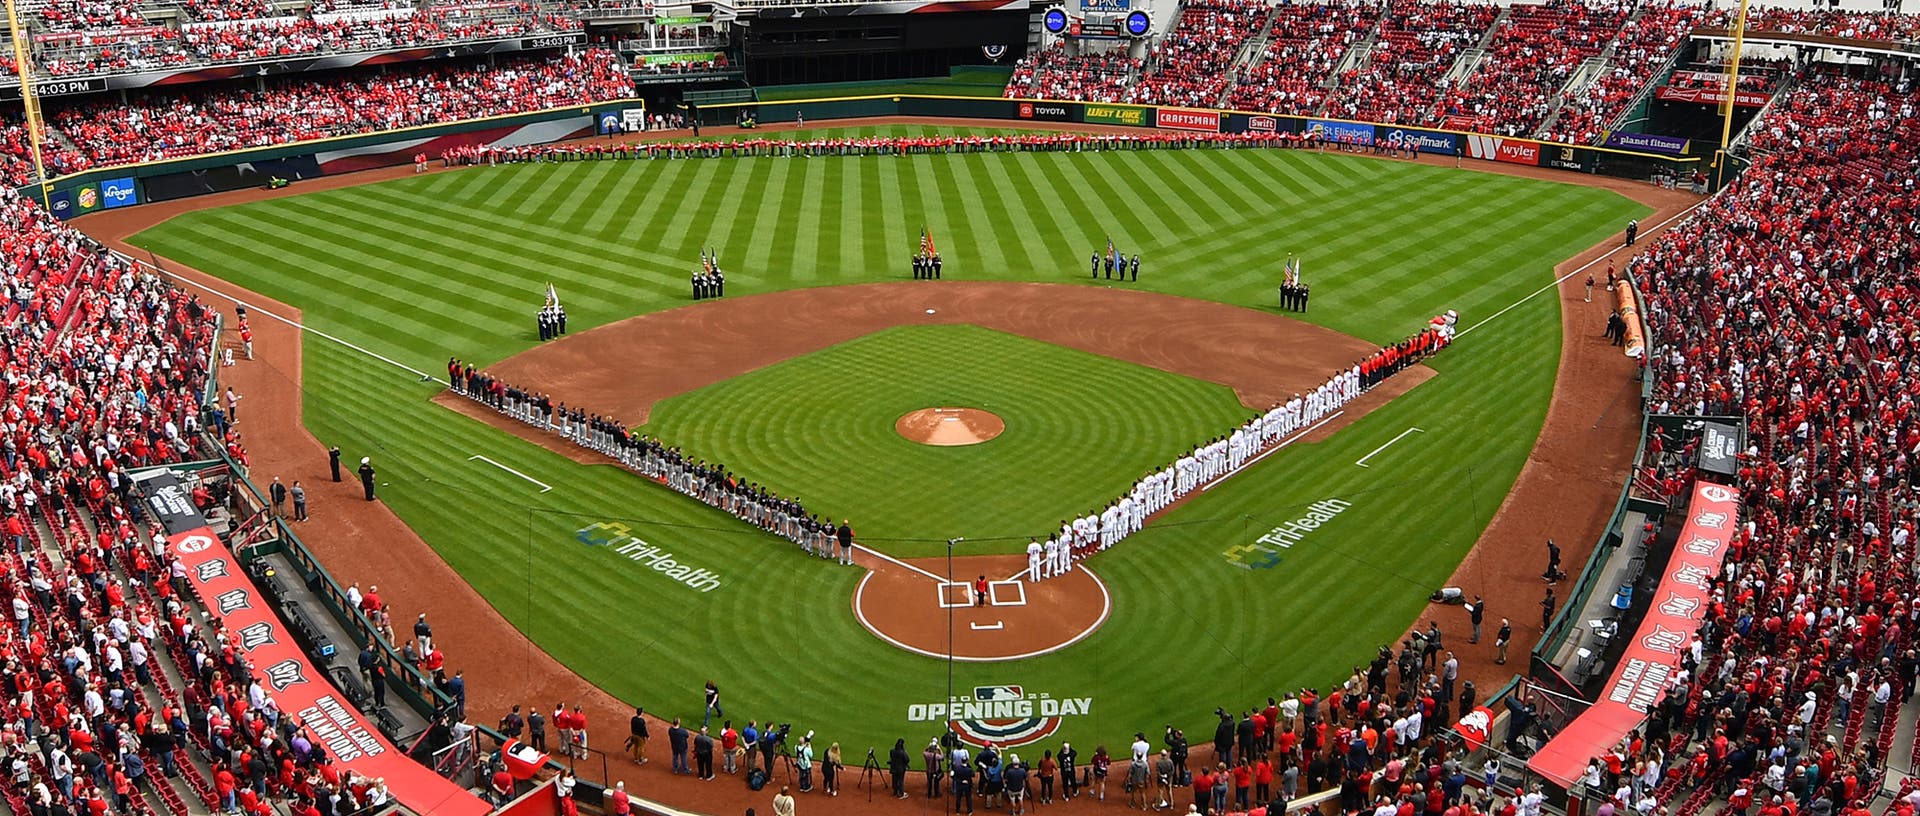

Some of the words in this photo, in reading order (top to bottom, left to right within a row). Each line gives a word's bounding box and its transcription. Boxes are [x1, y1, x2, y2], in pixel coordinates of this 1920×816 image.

[532, 38, 563, 48] 3:54:03
[564, 36, 577, 45] PM
[18, 84, 67, 97] 354:03
[69, 81, 90, 92] PM
[1701, 92, 1715, 100] THIS
[1736, 95, 1750, 103] FOR
[1035, 107, 1066, 116] TOYOTA
[1160, 113, 1217, 126] CRAFTSMAN
[1251, 119, 1274, 129] Swift
[1334, 127, 1372, 139] Elizabeth
[1405, 135, 1451, 149] Staffmark
[1620, 136, 1649, 146] planet
[1650, 138, 1681, 149] fitness
[1502, 145, 1536, 158] wyler
[1551, 159, 1582, 169] BETMGM
[104, 185, 134, 201] Kroger
[1256, 498, 1353, 549] TriHealth
[615, 537, 720, 593] TriHealth
[1664, 597, 1696, 618] 1940
[242, 623, 269, 647] 1970
[1648, 629, 1681, 651] 1919
[270, 660, 299, 687] 1972
[1609, 679, 1635, 703] WORLD
[1622, 657, 1646, 682] SERIES
[1628, 662, 1671, 714] CHAMPIONS
[907, 701, 1033, 722] OPENING
[1041, 697, 1093, 717] DAY
[298, 706, 363, 762] CHAMPIONS
[315, 695, 357, 731] NATIONAL
[347, 726, 385, 757] LEAGUE
